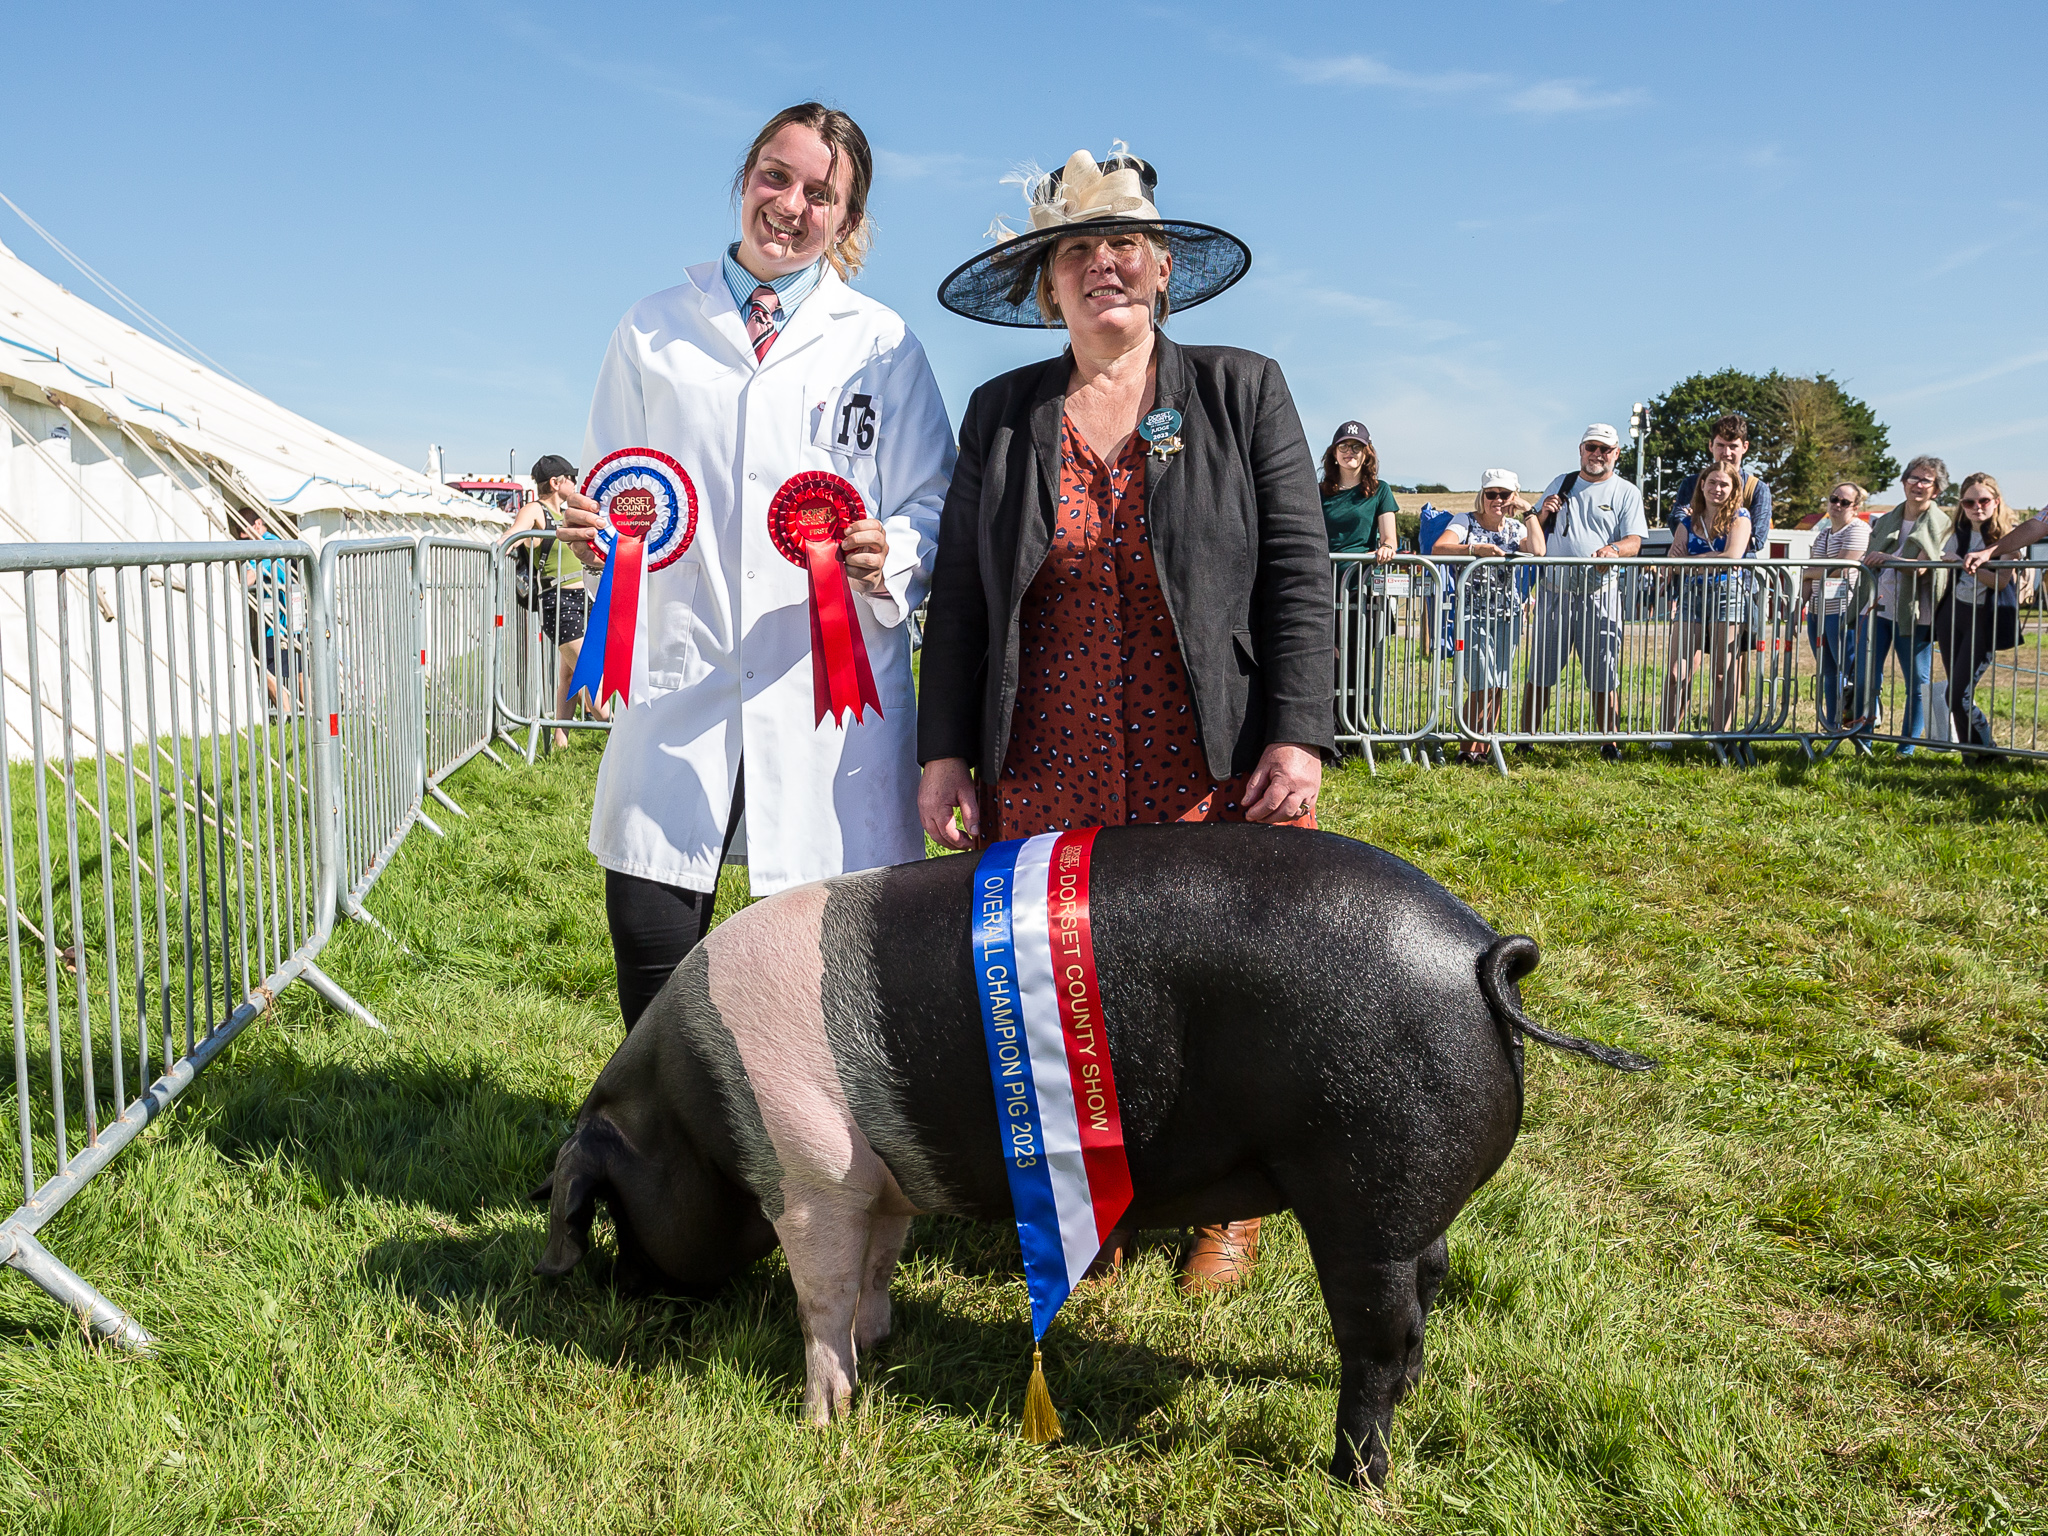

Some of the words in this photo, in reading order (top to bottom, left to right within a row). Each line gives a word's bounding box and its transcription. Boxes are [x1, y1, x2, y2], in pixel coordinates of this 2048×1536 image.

[1151, 425, 1170, 434] JUDGE
[1153, 432, 1169, 440] 2023
[616, 496, 651, 505] DORSET
[616, 504, 651, 512] COUNTY
[801, 506, 832, 517] DORSET
[802, 513, 832, 522] COUNTY
[809, 527, 829, 536] FIRST
[1070, 844, 1083, 868] DORSET
[983, 876, 1005, 962] OVERALL
[1059, 874, 1081, 958] DORSET
[986, 965, 1023, 1076] CHAMPION
[1065, 964, 1097, 1057] COUNTY
[1004, 1081, 1029, 1117] PIG
[1082, 1064, 1109, 1132] SHOW
[1011, 1122, 1037, 1168] 2023
